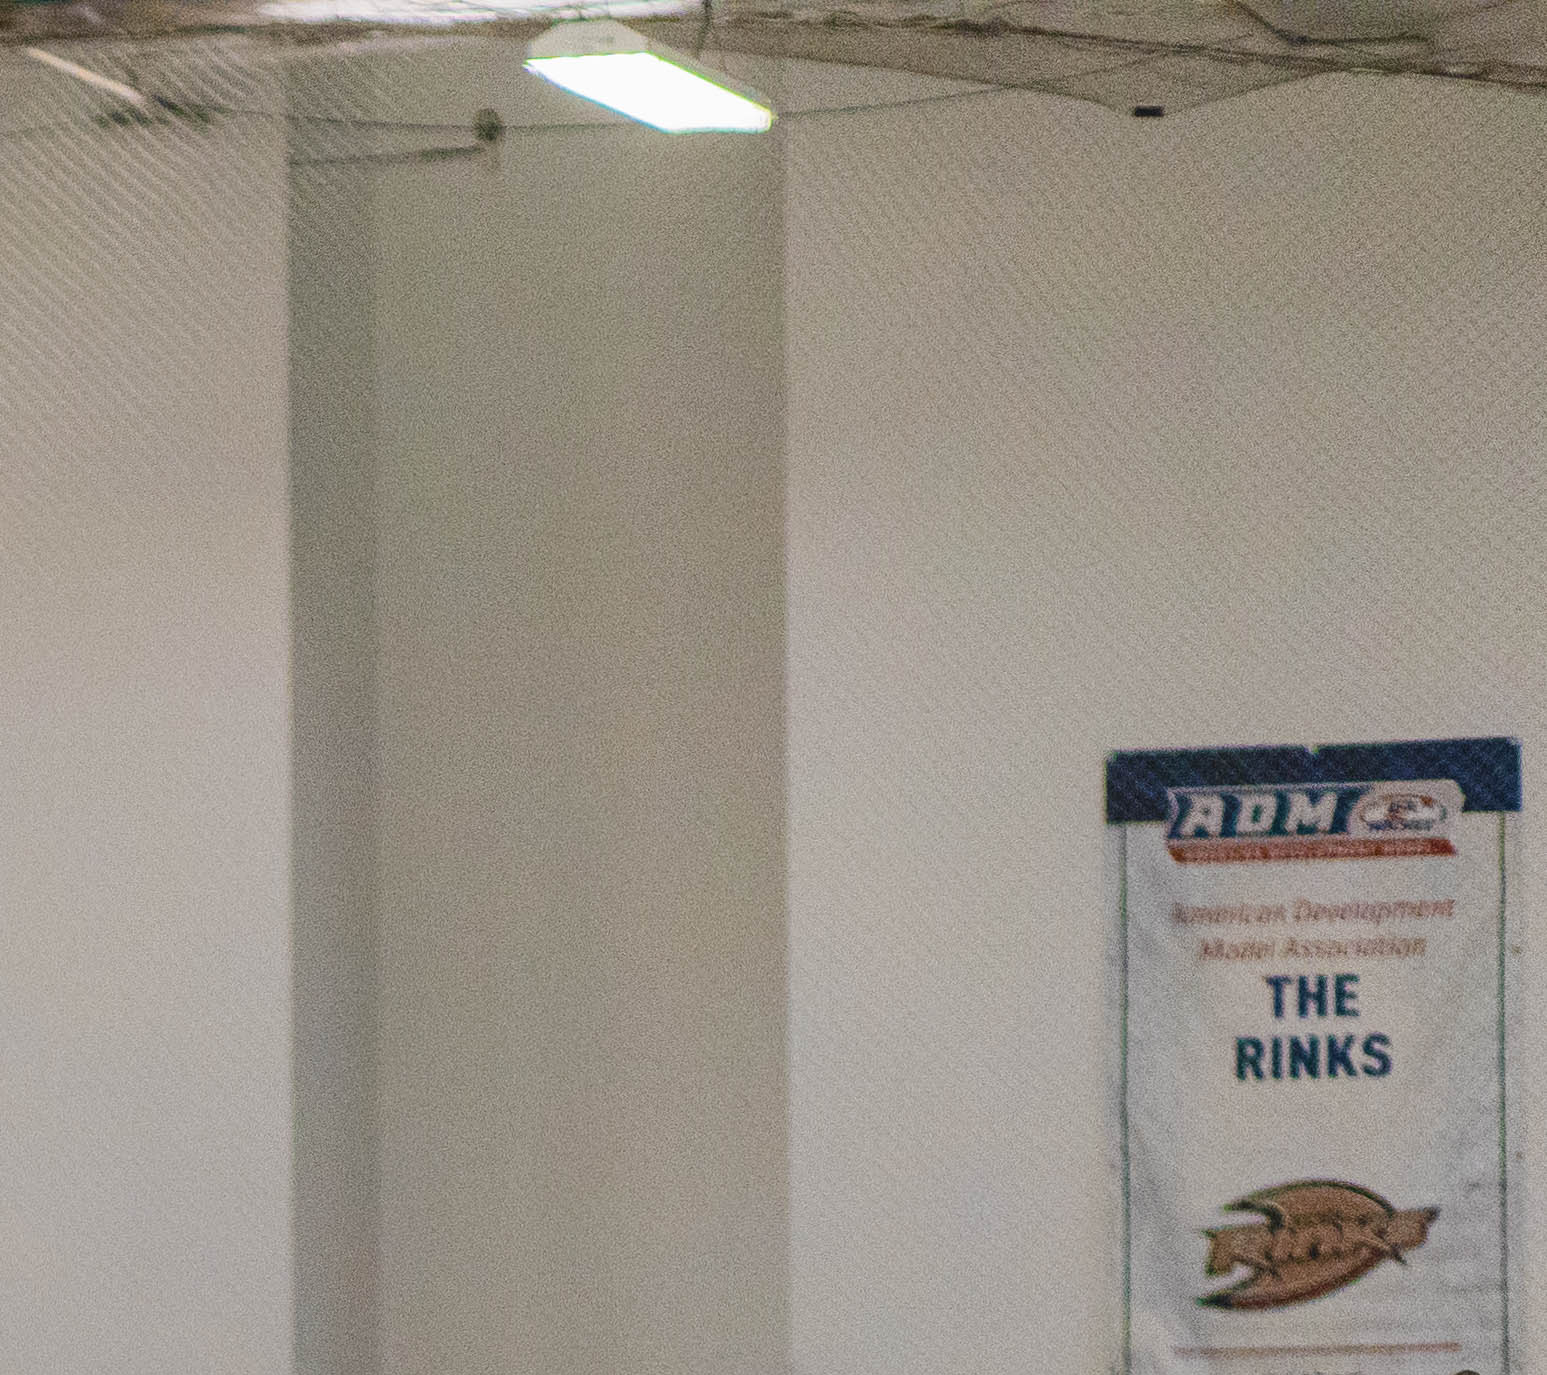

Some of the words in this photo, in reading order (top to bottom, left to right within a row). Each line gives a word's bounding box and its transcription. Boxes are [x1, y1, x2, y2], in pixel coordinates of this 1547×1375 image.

[1179, 790, 1340, 837] ADM
[1265, 973, 1361, 1019] THE
[1235, 1032, 1394, 1081] RINKS
